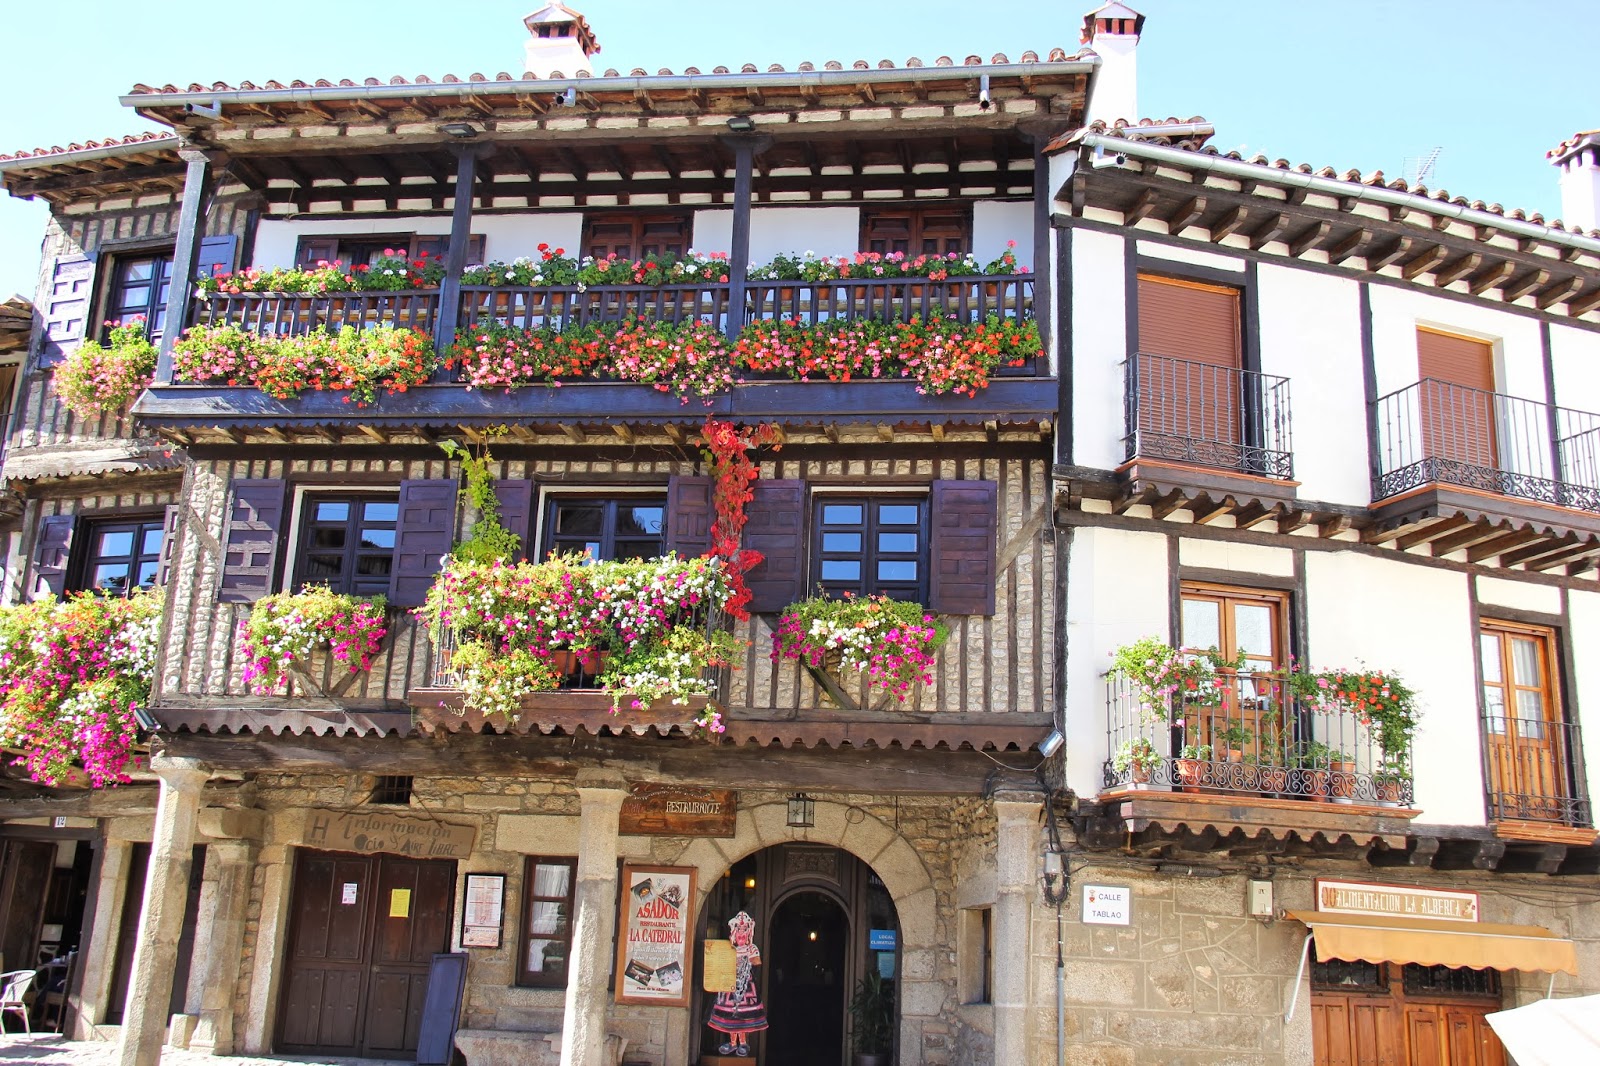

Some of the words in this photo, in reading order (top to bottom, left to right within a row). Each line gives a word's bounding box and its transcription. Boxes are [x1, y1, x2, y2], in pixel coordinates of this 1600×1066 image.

[666, 801, 721, 814] RESTAURANTE
[57, 816, 65, 826] 12
[1098, 893, 1121, 901] CALLE
[1336, 890, 1400, 912] ALIMENTACION
[1405, 895, 1416, 913] LA
[1421, 898, 1461, 917] ALBERCA
[636, 897, 679, 920] ASADOR
[1092, 910, 1122, 919] TABLAO
[629, 928, 640, 941] LA
[642, 929, 683, 943] CATEDRAL
